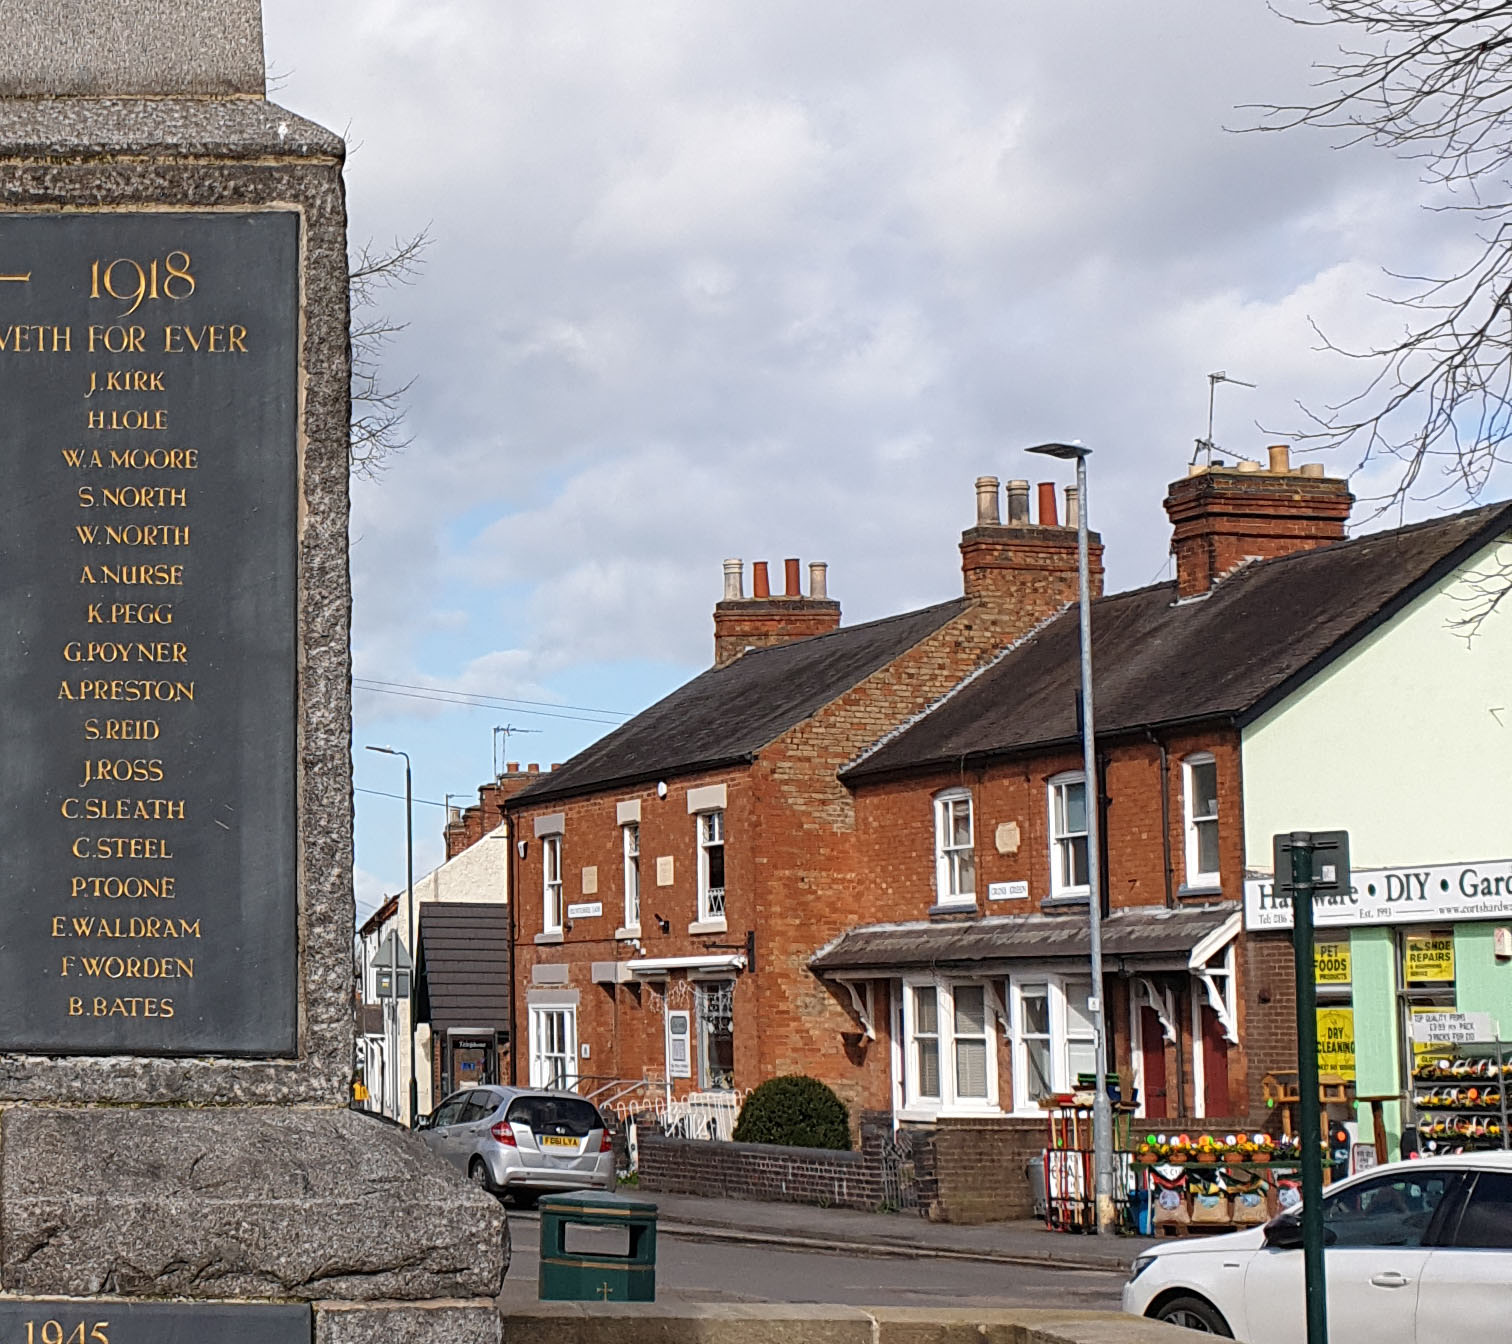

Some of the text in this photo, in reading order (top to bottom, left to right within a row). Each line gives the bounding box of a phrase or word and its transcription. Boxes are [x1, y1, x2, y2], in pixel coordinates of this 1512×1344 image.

[90, 251, 196, 317] 1918
[89, 324, 146, 353] FOR
[164, 325, 248, 353] EVER
[1258, 879, 1358, 910] Haware
[1385, 872, 1431, 902] DIY
[1320, 945, 1339, 958] PET
[1425, 940, 1451, 951] SHOE
[1409, 952, 1451, 963] REPAIRS
[1327, 1027, 1344, 1039] DRY
